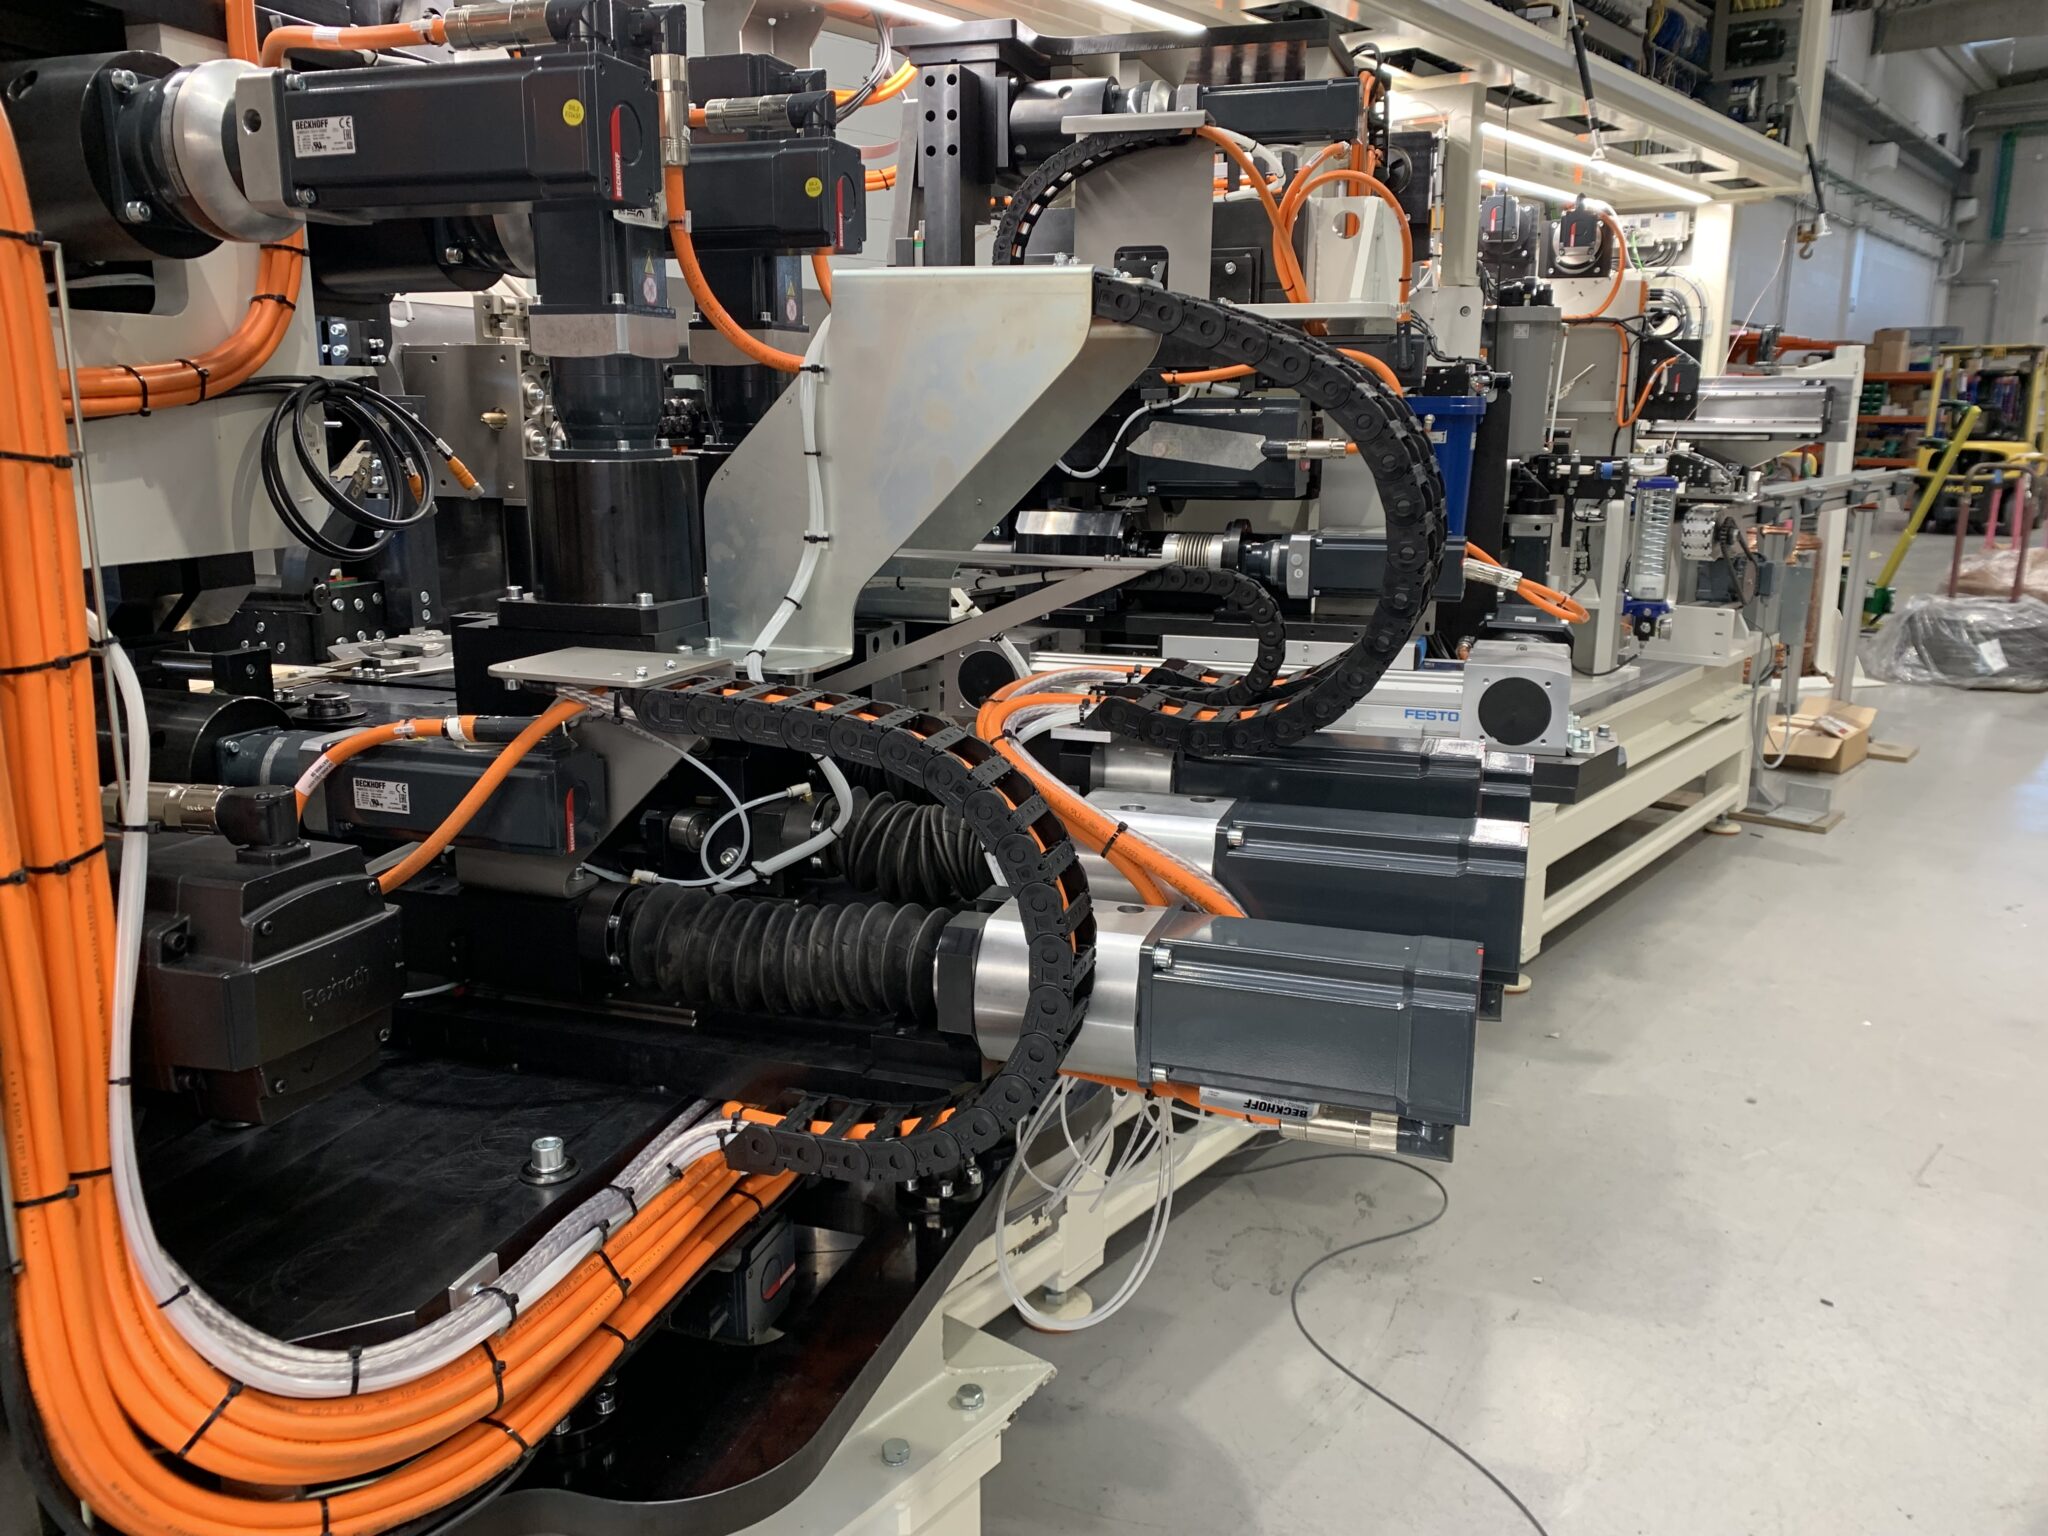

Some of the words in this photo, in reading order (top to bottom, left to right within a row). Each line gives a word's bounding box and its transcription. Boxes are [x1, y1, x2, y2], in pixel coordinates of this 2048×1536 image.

[296, 119, 328, 130] BECKHOFF
[614, 151, 623, 197] BECKHOFF
[1404, 708, 1459, 722] FESTO
[355, 779, 385, 790] BECKHOFF
[1243, 1099, 1309, 1118] BECKHOFF
